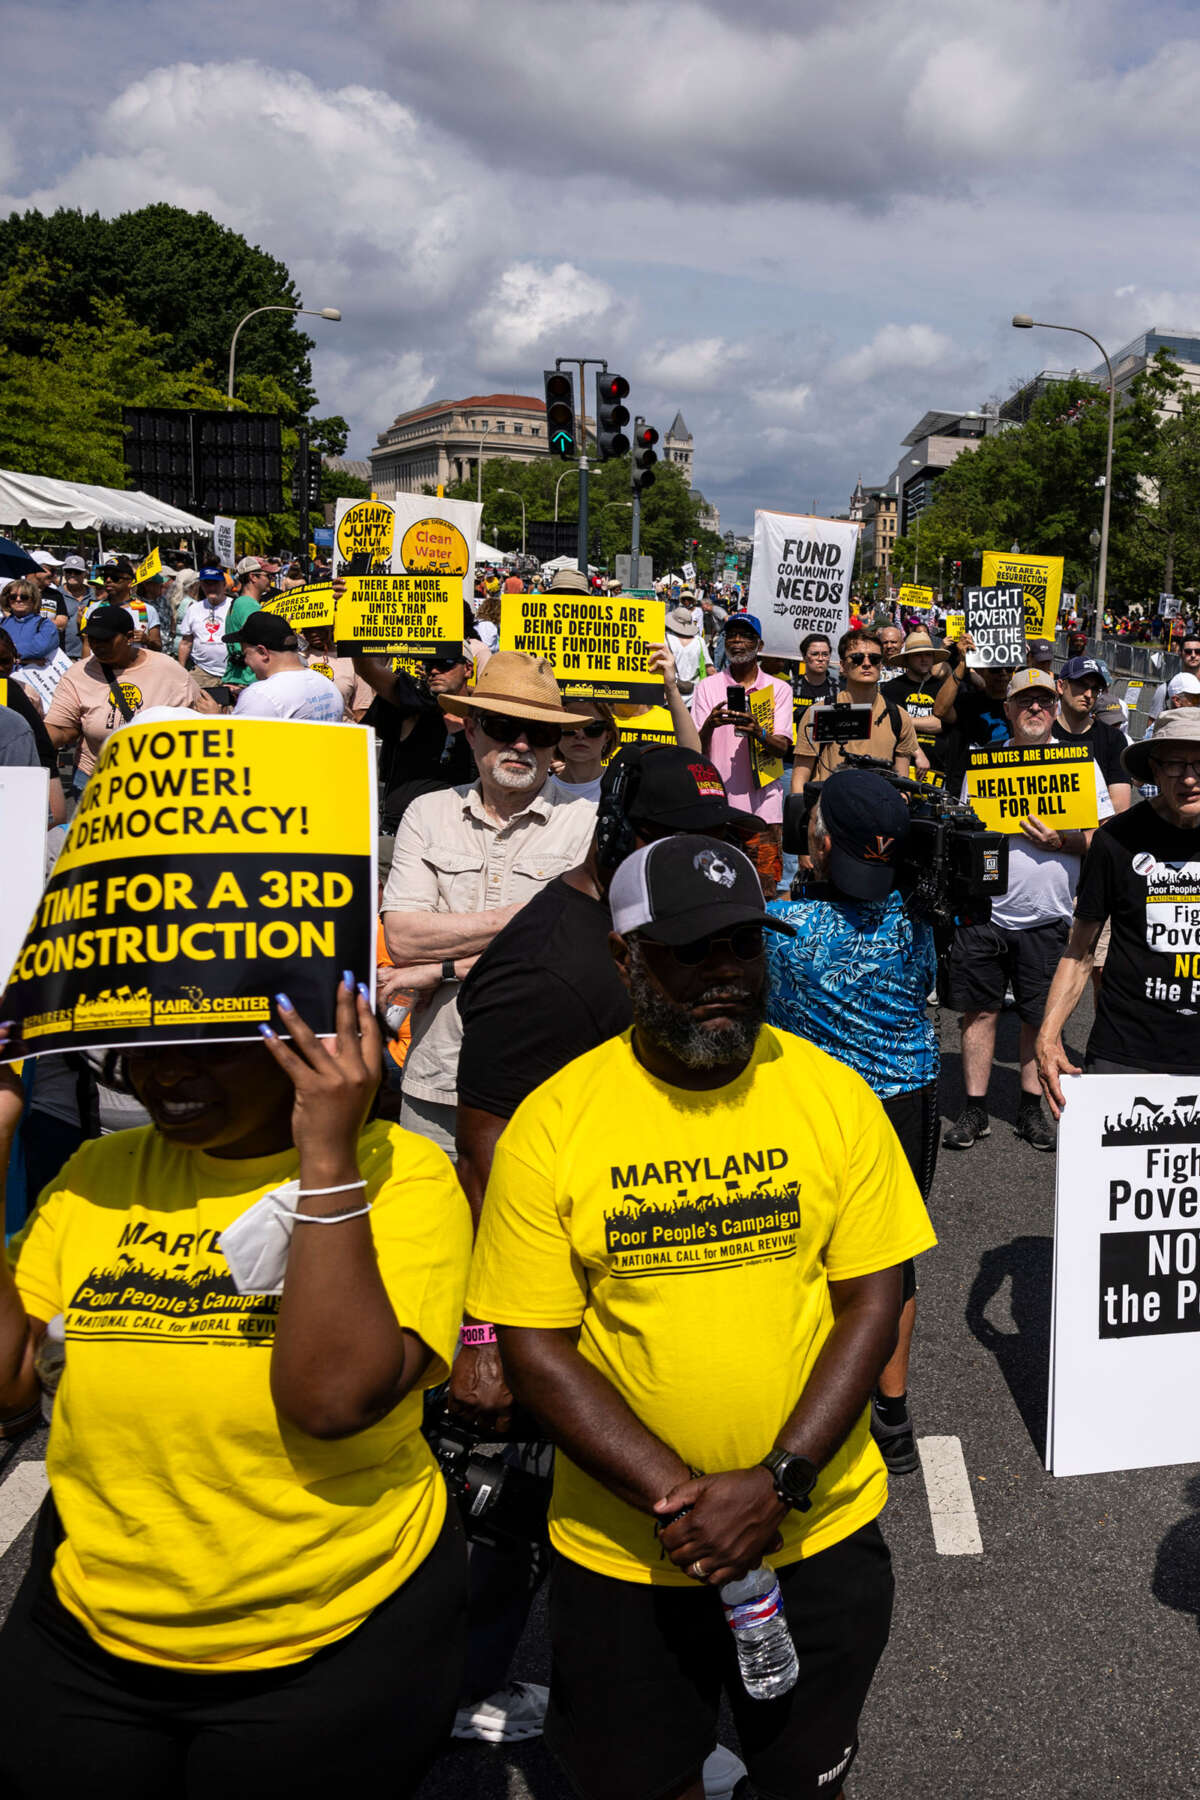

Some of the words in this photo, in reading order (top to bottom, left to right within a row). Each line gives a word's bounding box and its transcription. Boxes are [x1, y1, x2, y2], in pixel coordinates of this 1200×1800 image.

[345, 508, 392, 525] ADELANTE
[416, 531, 452, 544] Clean
[415, 545, 452, 558] Water
[783, 539, 841, 567] FUND
[777, 563, 844, 580] COMMUNITY
[997, 572, 1048, 584] RESURRECTION
[359, 580, 388, 590] THERE
[392, 580, 410, 590] ARE
[414, 580, 441, 590] MORE
[776, 577, 843, 604] NEEDS
[276, 596, 310, 608] ADDRESS
[352, 592, 403, 602] AVAILABLE
[407, 592, 448, 602] HOUSING
[968, 589, 1022, 610] FIGHT
[308, 602, 324, 610] AND
[369, 603, 397, 614] UNITS
[402, 603, 426, 614] THAN
[522, 603, 547, 618] OUR
[553, 603, 613, 621] SCHOOLS
[619, 607, 645, 623] ARE
[789, 605, 843, 620] CORPORATE
[291, 610, 328, 620] ECONOMY
[361, 615, 378, 625] THE
[382, 615, 422, 626] NUMBER
[427, 615, 438, 626] OF
[969, 607, 1022, 628] POVERTY
[353, 627, 403, 637] UNHOUSED
[408, 627, 446, 638] PEOPLE.
[524, 619, 562, 635] BEING
[793, 618, 836, 633] GREED!
[514, 635, 556, 651] WHILE
[562, 637, 620, 654] FUNDING
[626, 640, 650, 655] FOR
[969, 629, 996, 645] NOT
[997, 628, 1022, 644] THE
[563, 653, 580, 669] ON
[586, 655, 611, 670] THE
[1028, 670, 1040, 684] P
[128, 728, 235, 763] VOTE!
[971, 753, 988, 765] OUR
[991, 750, 1020, 763] VOTES
[1023, 749, 1041, 762] ARE
[1044, 746, 1088, 760] DEMANDS
[107, 766, 252, 805] POWER!
[977, 773, 1080, 798] HEALTHCARE
[1000, 797, 1030, 818] FOR
[1037, 795, 1066, 816] ALL
[75, 806, 309, 850] DEMOCRACY!
[1149, 886, 1167, 894] Poor
[40, 879, 99, 929] TIME
[105, 872, 198, 916] FOR
[206, 871, 249, 911] A
[258, 870, 354, 909] 3RD
[1145, 977, 1181, 1001] the
[213, 996, 269, 1011] CENTER
[610, 1147, 789, 1190] MARYLAND
[609, 1231, 647, 1247] Poor
[652, 1222, 717, 1244] People's
[721, 1209, 799, 1235] Campaign
[622, 1252, 673, 1267] NATIONAL
[676, 1249, 701, 1262] CALL
[704, 1247, 717, 1259] for
[720, 1244, 755, 1258] MORAL
[758, 1234, 796, 1250] REVIVAL
[76, 1287, 119, 1306] Poor
[119, 1287, 199, 1313] People's
[1104, 1284, 1161, 1325] the
[74, 1316, 128, 1328] NATIONAL
[133, 1316, 164, 1330] CALL
[167, 1321, 187, 1333] for
[189, 1318, 230, 1332] MORAL
[462, 1328, 485, 1342] POOR
